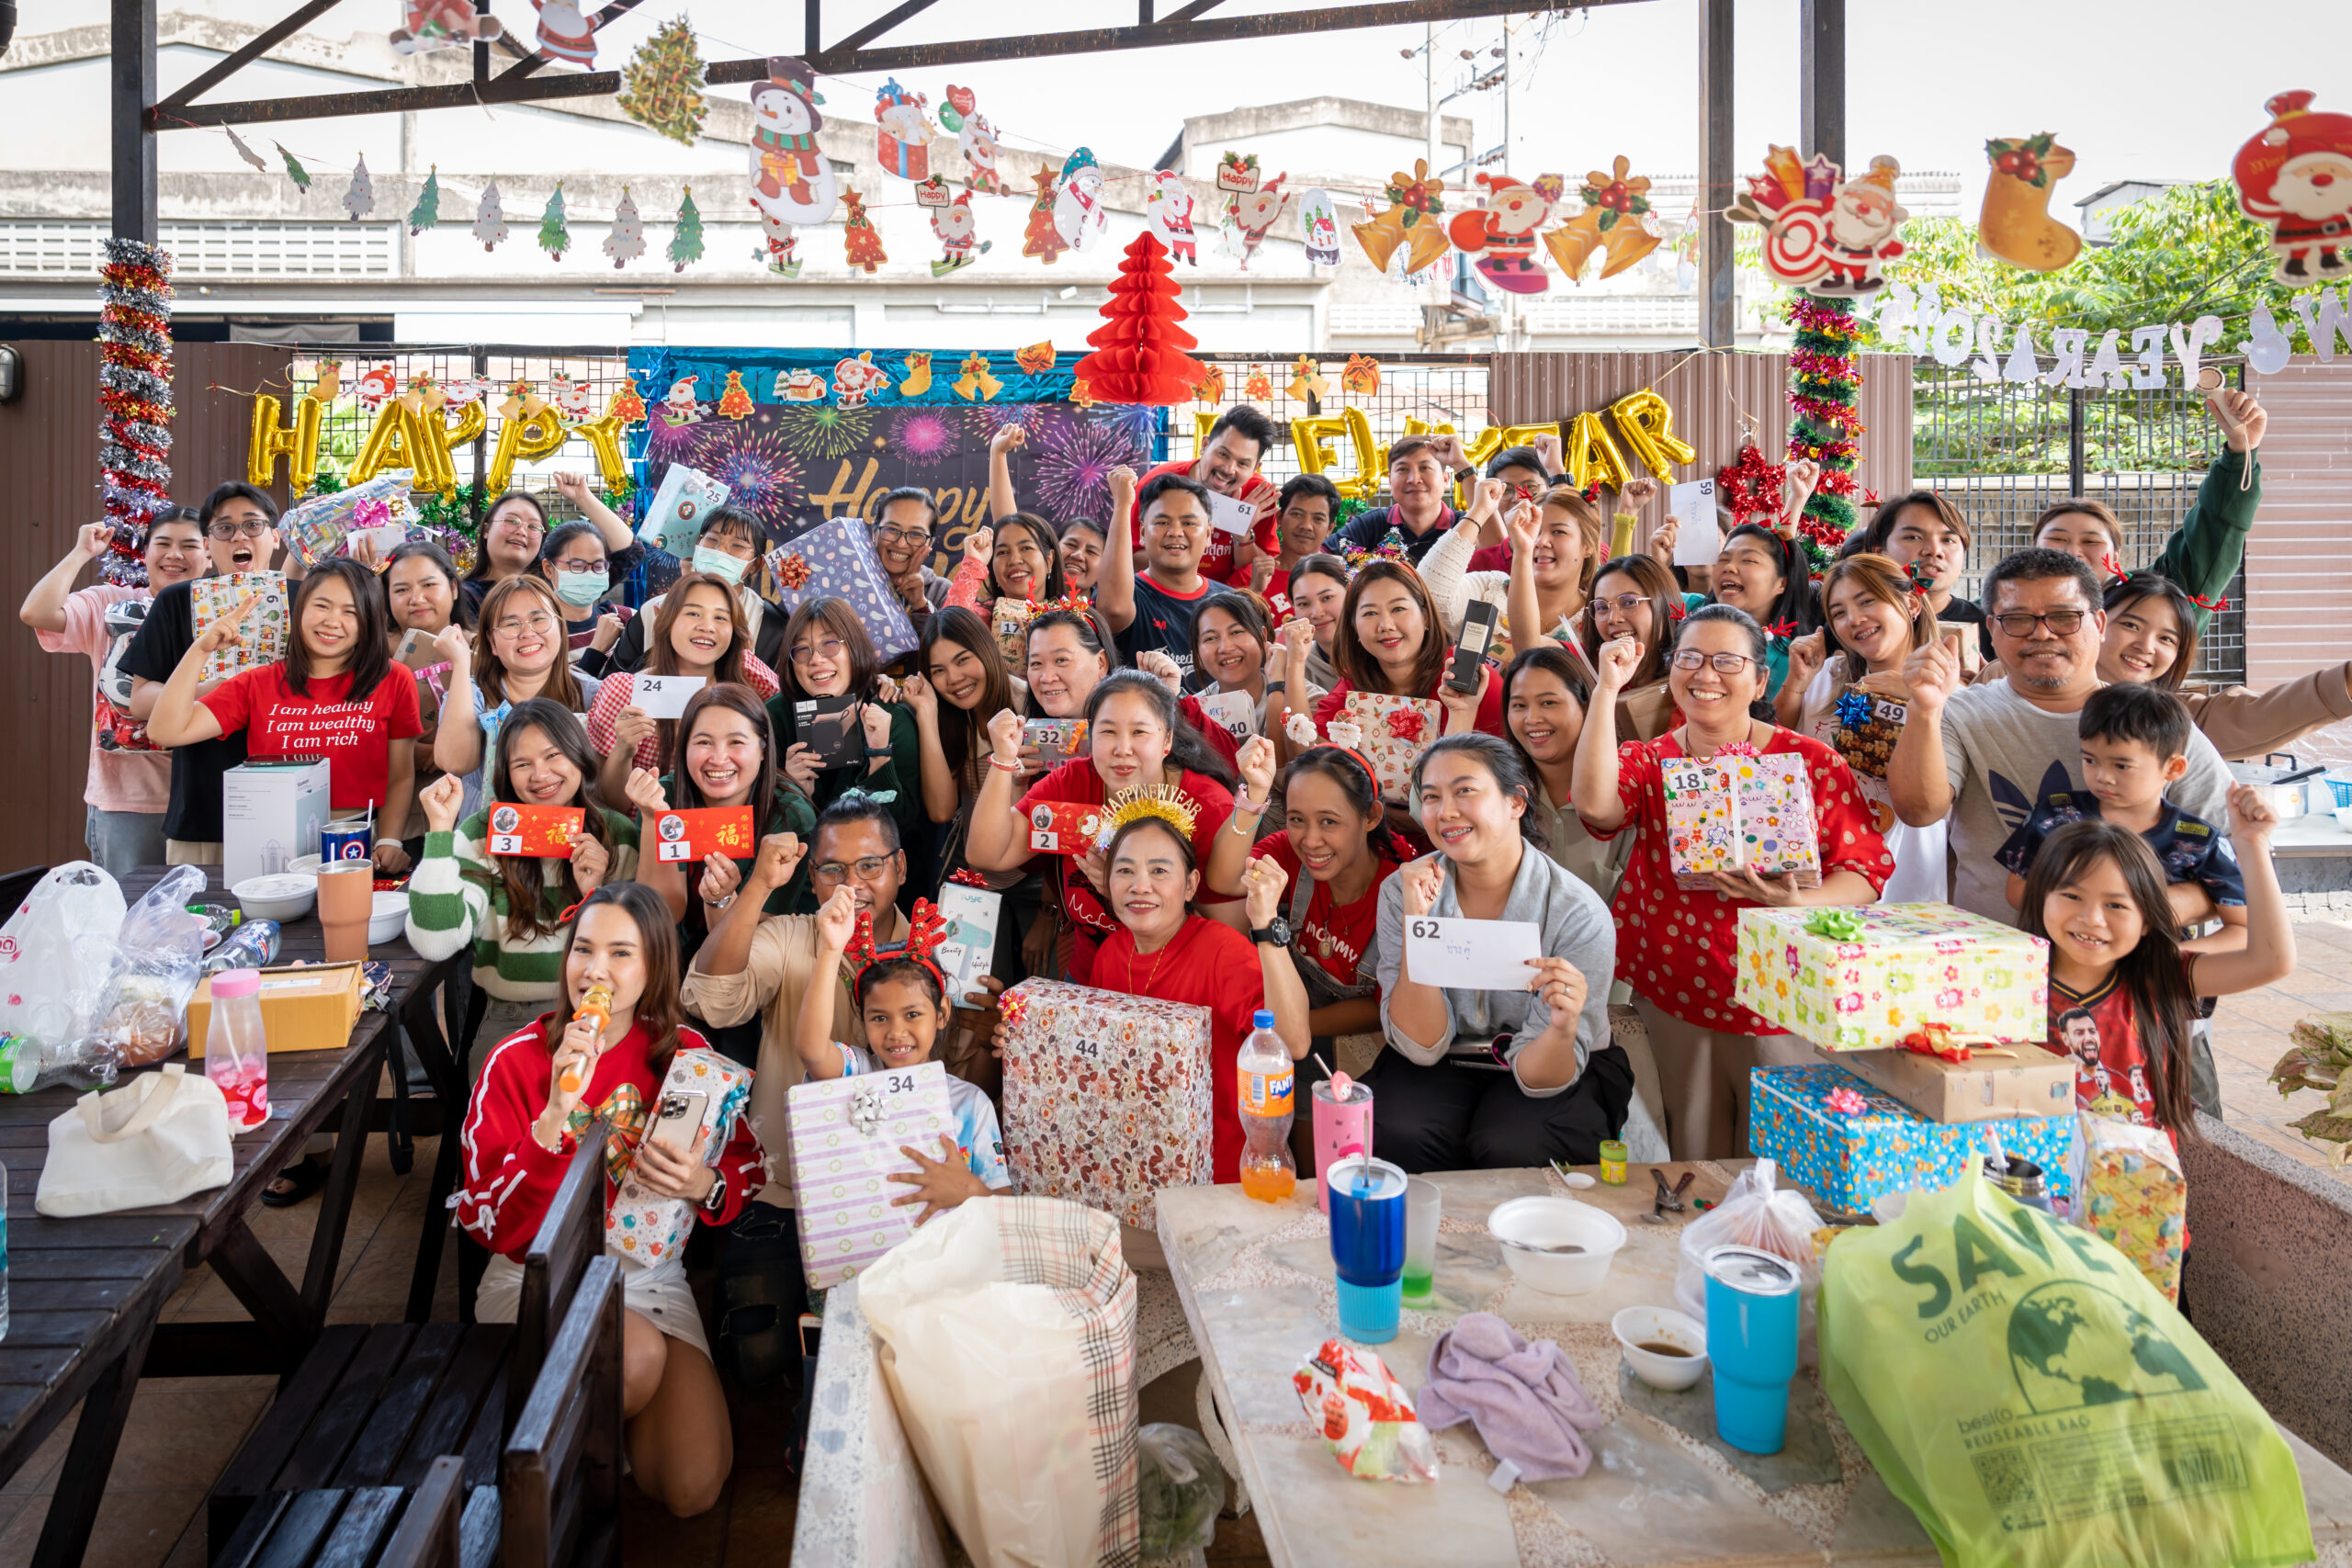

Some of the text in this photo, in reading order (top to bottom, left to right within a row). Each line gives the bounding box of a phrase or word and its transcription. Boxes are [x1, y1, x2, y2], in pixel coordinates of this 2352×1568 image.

[1222, 172, 1255, 187] Happy
[920, 190, 945, 200] Happy
[247, 393, 629, 507] HAPPY
[1700, 481, 1713, 495] 59
[706, 490, 721, 503] 25
[1238, 504, 1251, 515] 61
[767, 549, 784, 565] 14
[1003, 623, 1020, 634] 17
[643, 680, 662, 691] 24
[268, 698, 374, 716] I am healthy
[1879, 705, 1904, 721] 49
[266, 715, 376, 733] I am wealthy
[1228, 721, 1247, 735] 40
[281, 732, 358, 749] I am rich
[1039, 730, 1059, 744] 32
[1674, 773, 1701, 790] 18
[546, 822, 569, 845] 福
[715, 822, 740, 847] 福
[1040, 833, 1050, 848] 2
[501, 837, 512, 852] 3
[670, 843, 680, 858] 1
[1412, 920, 1441, 939] 62
[941, 946, 963, 956] Beauty
[1076, 1039, 1099, 1058] 44
[888, 1075, 914, 1093] 34
[1891, 1208, 2119, 1319] SAVE
[1924, 1289, 2007, 1345] OUR EARTH
[1964, 1413, 2093, 1451] REUSEABLE BAG
